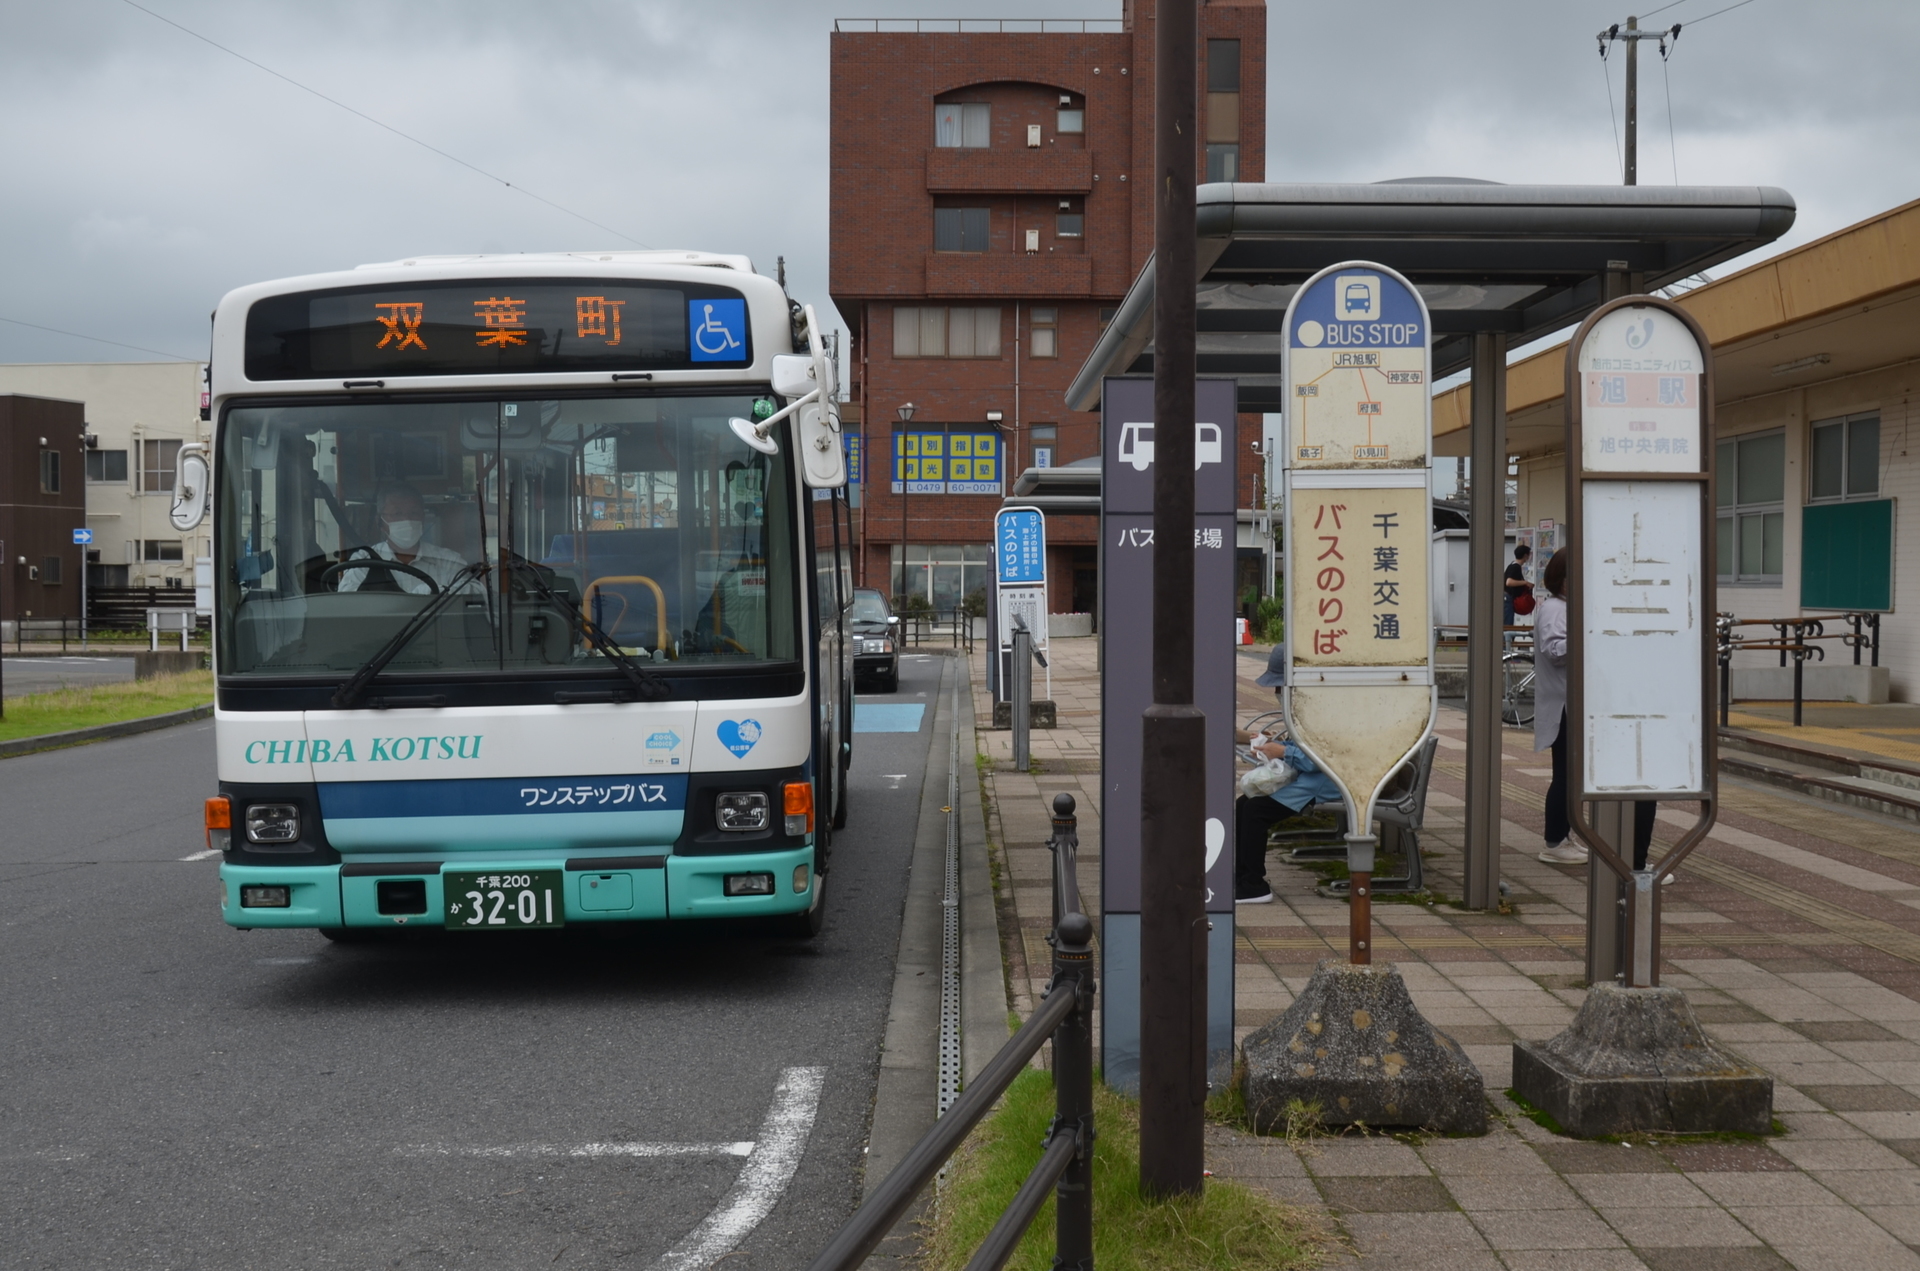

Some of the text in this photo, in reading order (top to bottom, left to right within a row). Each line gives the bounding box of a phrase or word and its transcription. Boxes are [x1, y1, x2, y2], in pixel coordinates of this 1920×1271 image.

[375, 295, 626, 350] 双葉町
[1327, 323, 1418, 345] BUS STOP
[1335, 353, 1378, 366] JR旭駅
[1389, 372, 1420, 383] 神宮寺
[1600, 377, 1686, 405] 旭駅
[1359, 403, 1380, 413] 府馬
[1355, 447, 1387, 458] 小見川
[1599, 437, 1689, 455] 旭中央病院
[897, 483, 996, 492] TL 0479 60-0071
[1004, 515, 1019, 578] バスのりば
[1117, 527, 1224, 549] バス場
[1313, 503, 1348, 656] バスのりば
[1372, 512, 1401, 641] 千葉交通
[245, 735, 483, 764] CHIBA KOTSU
[519, 784, 668, 806] ワンステップバス
[450, 889, 553, 925] か 32-01
